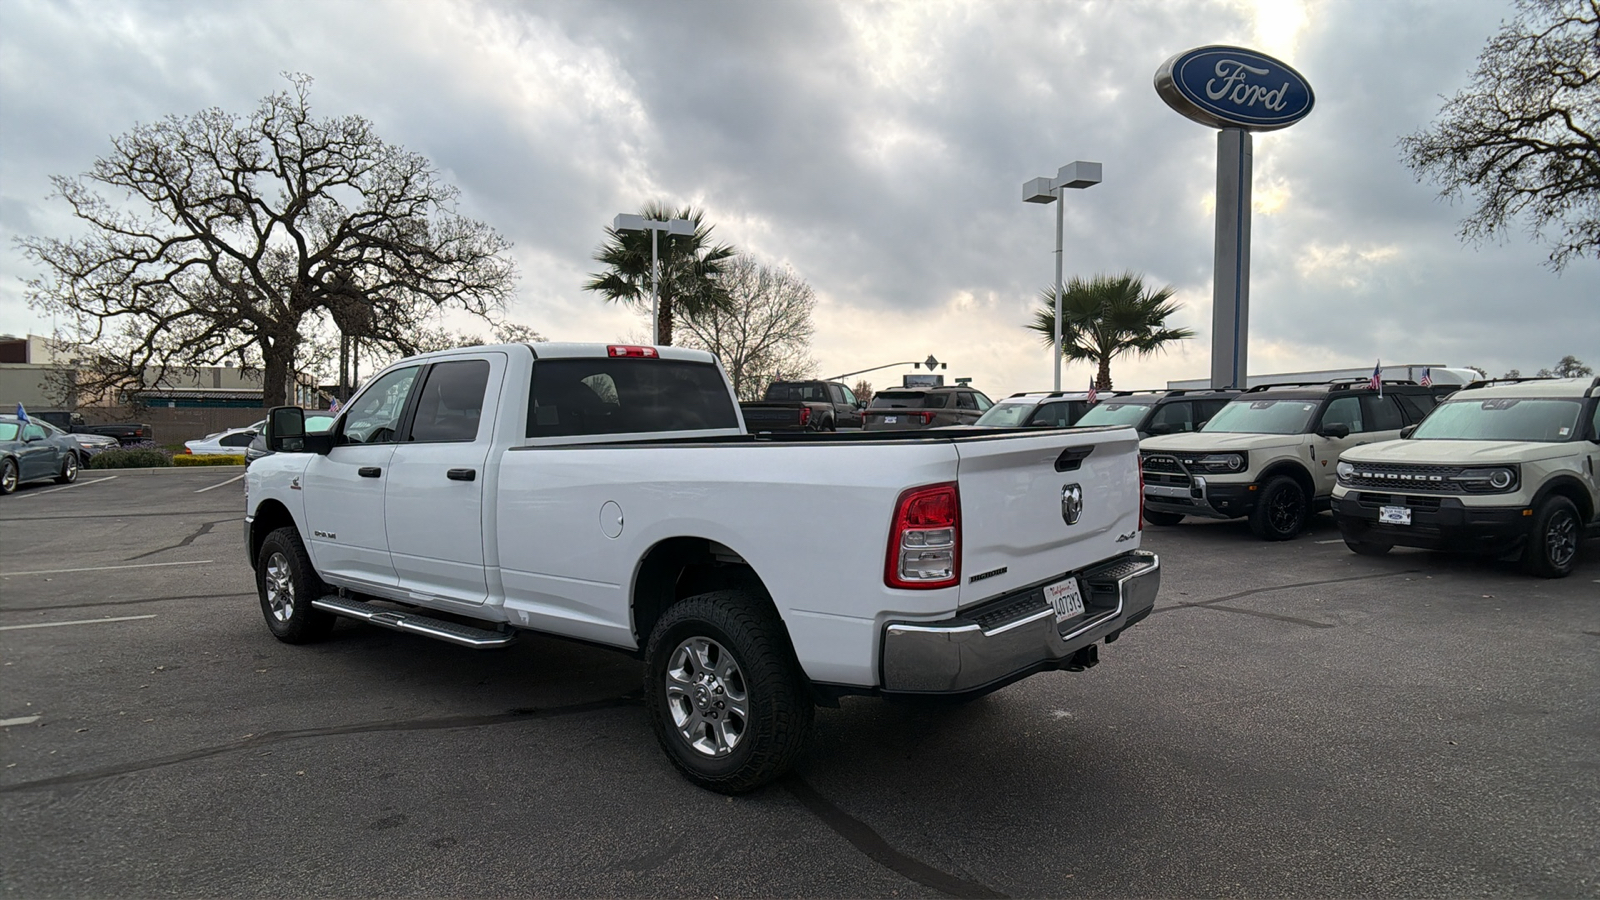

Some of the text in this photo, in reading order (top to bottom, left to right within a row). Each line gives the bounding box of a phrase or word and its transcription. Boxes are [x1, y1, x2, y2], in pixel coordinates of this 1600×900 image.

[1205, 59, 1290, 112] Ford
[1143, 457, 1193, 465] RONO
[1362, 472, 1442, 481] BRONCO
[1051, 592, 1082, 618] 4073Y3
